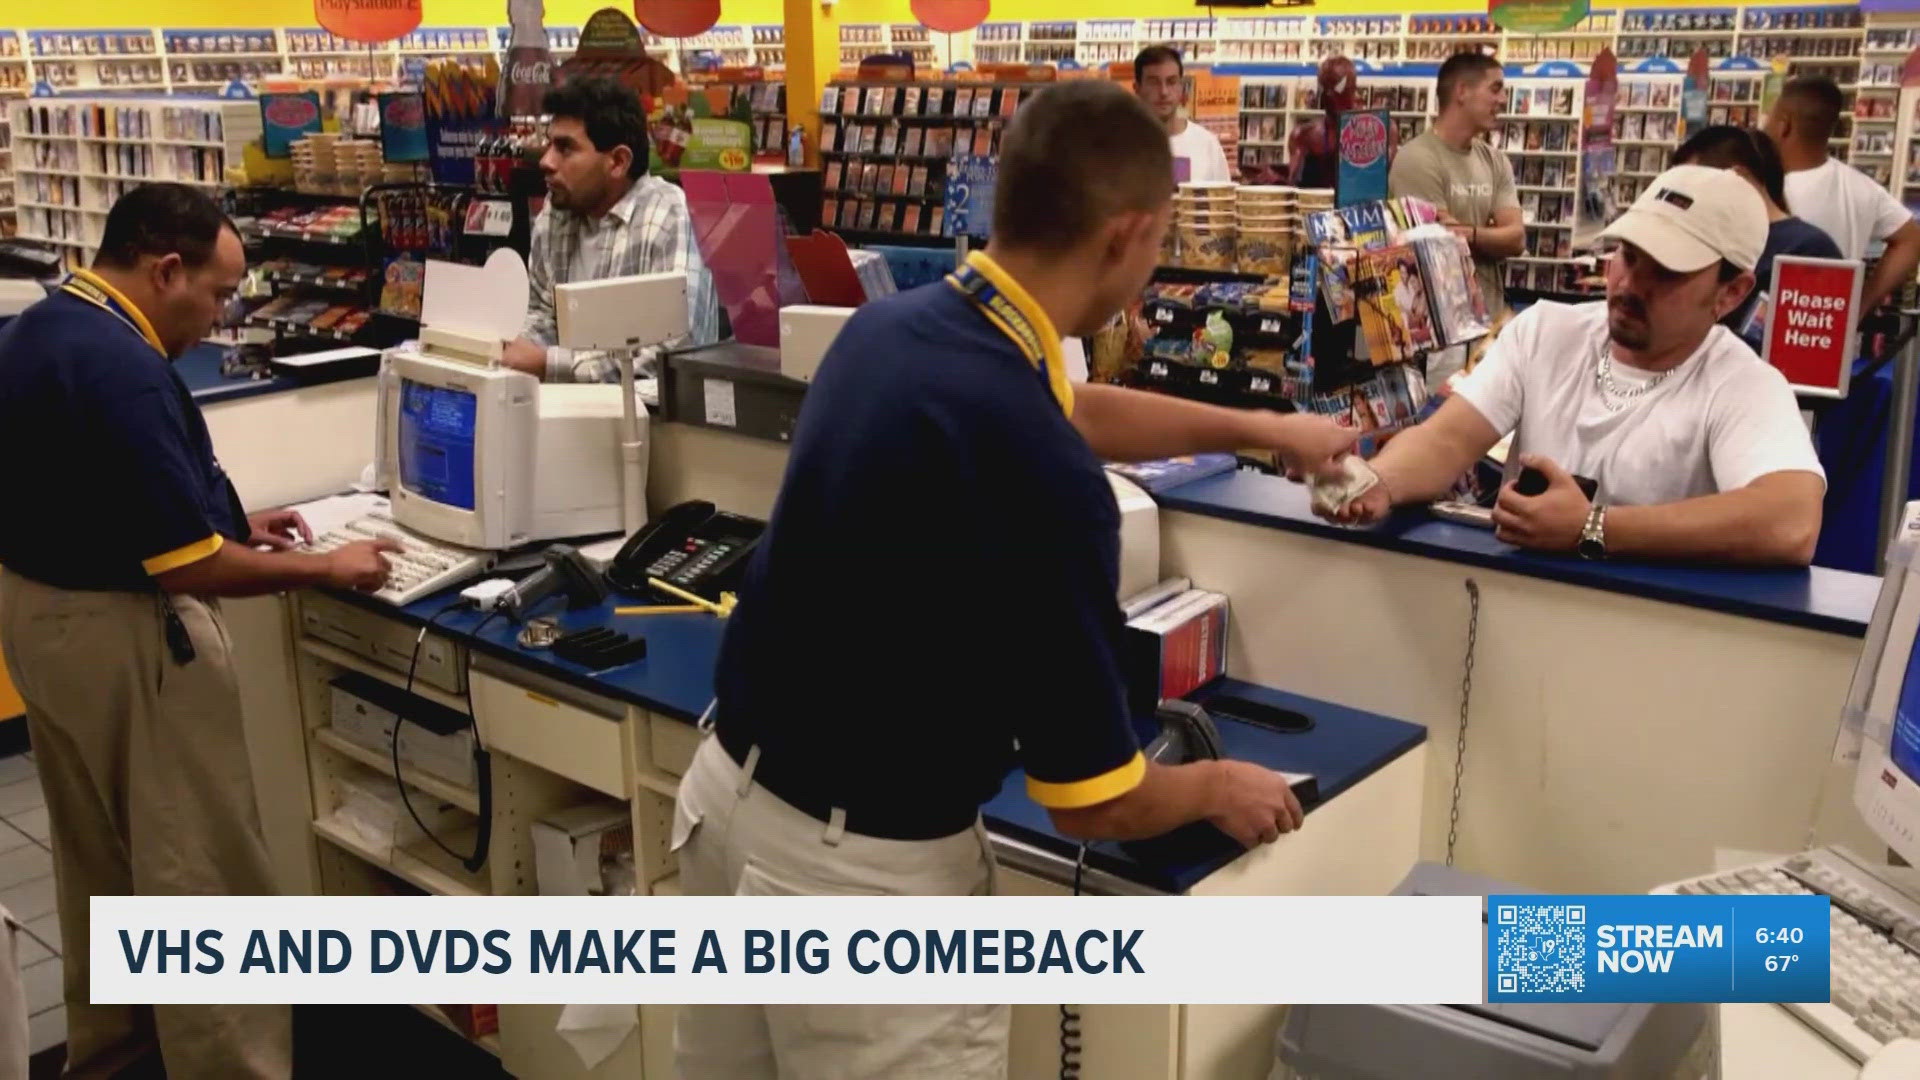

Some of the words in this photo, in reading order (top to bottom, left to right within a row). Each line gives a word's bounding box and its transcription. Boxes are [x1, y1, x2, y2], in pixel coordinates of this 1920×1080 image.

[1313, 205, 1381, 238] MXIM
[1781, 289, 1846, 311] Please
[1788, 309, 1834, 330] Wait
[1785, 329, 1831, 349] Here
